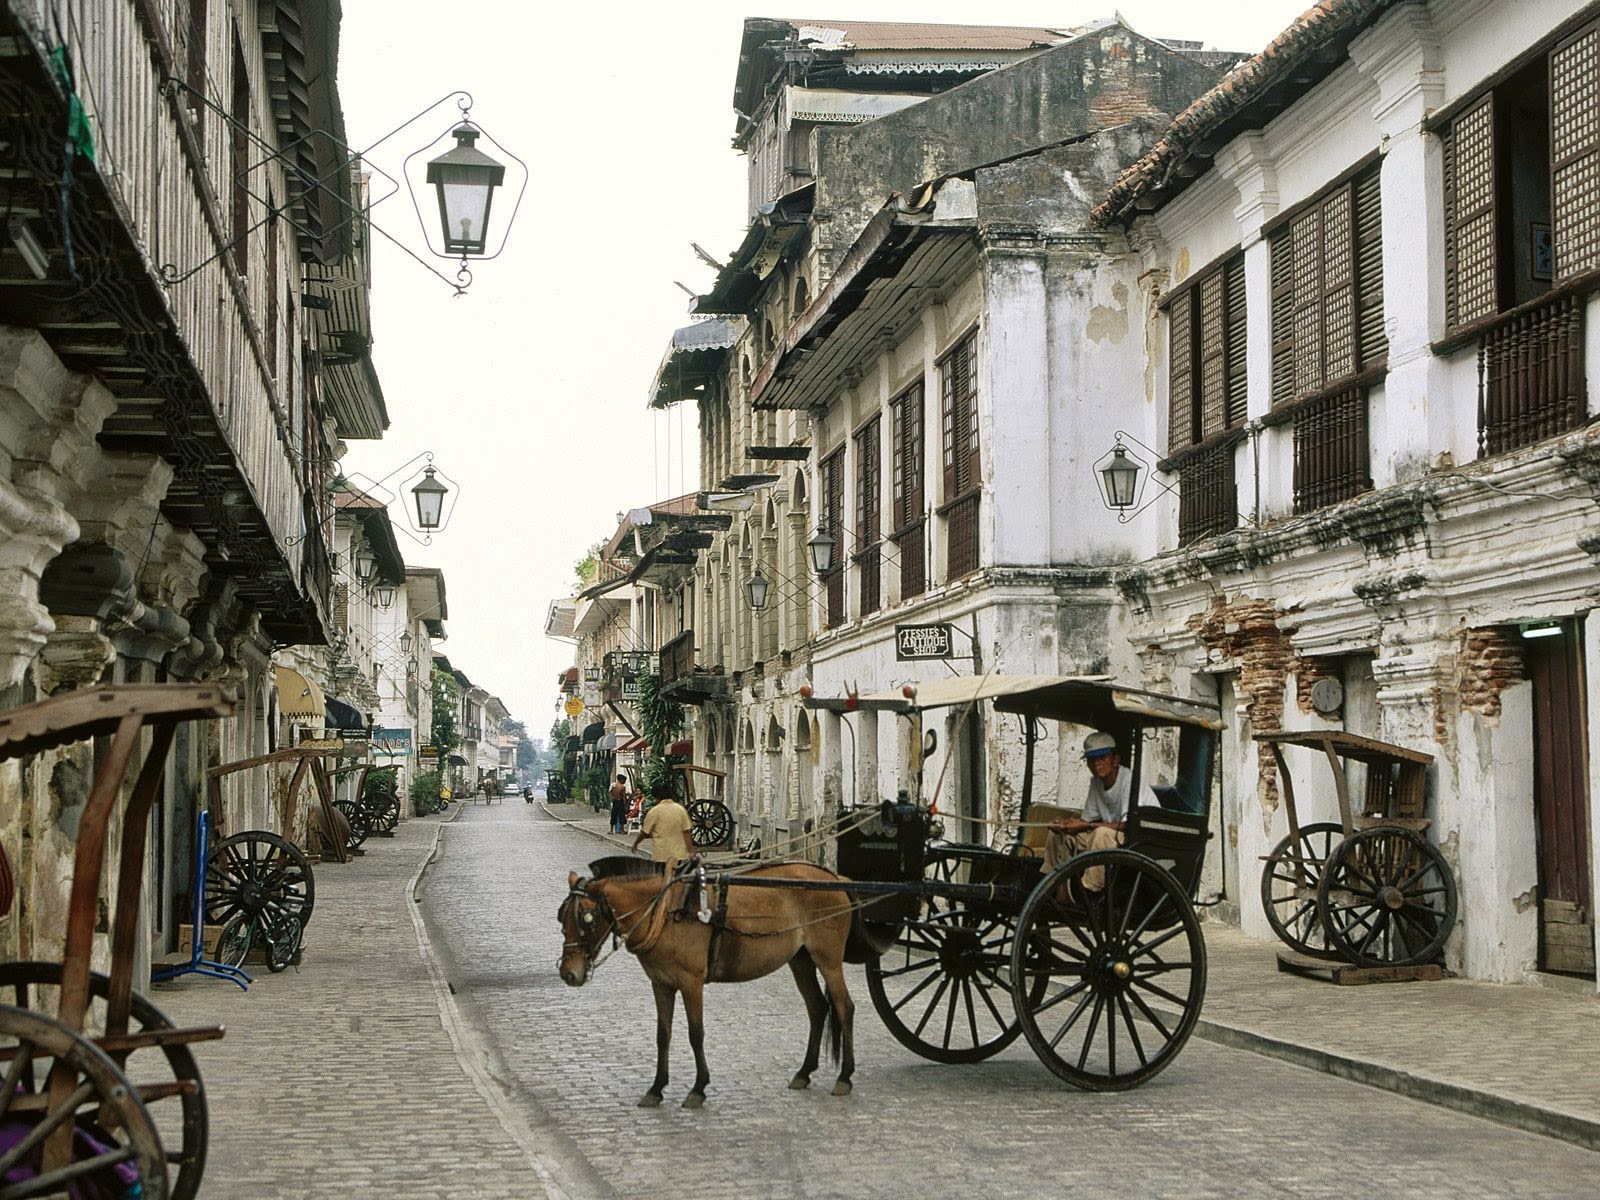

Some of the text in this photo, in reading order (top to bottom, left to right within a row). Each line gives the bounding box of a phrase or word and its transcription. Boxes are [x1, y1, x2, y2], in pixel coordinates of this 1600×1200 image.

[904, 626, 939, 638] TESSIE'S
[902, 636, 945, 648] ANTIQUE
[913, 646, 937, 656] SHOP
